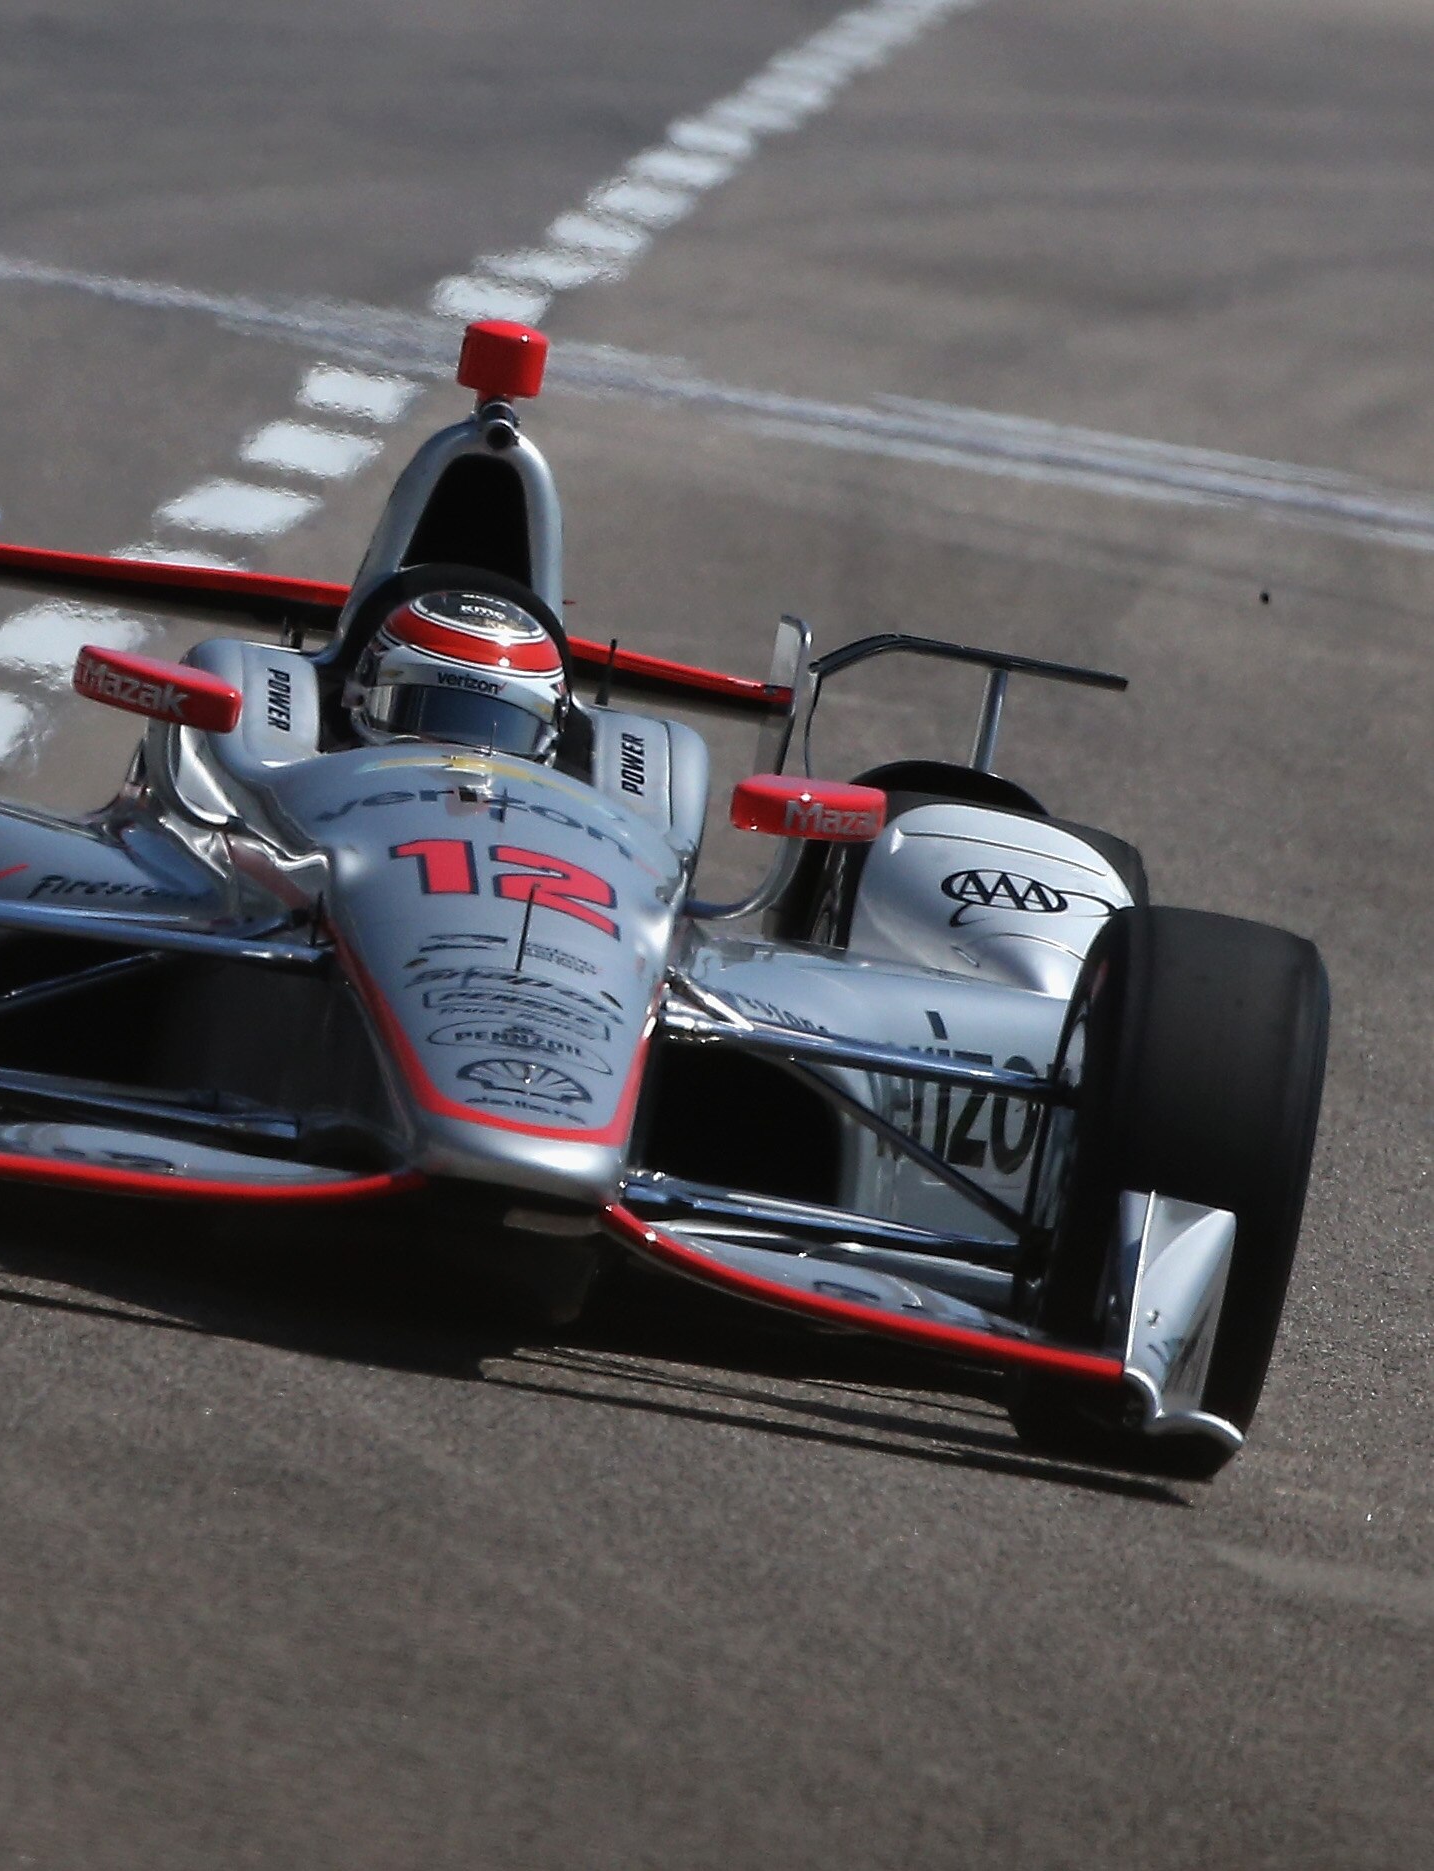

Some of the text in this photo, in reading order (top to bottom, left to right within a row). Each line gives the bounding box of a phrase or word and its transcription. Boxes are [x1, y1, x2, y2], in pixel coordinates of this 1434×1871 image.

[267, 667, 291, 731] POWER
[437, 671, 501, 695] verizon
[621, 732, 646, 797] POWER
[784, 799, 878, 835] Maza
[388, 838, 621, 942] 12
[954, 869, 1056, 912] AAA
